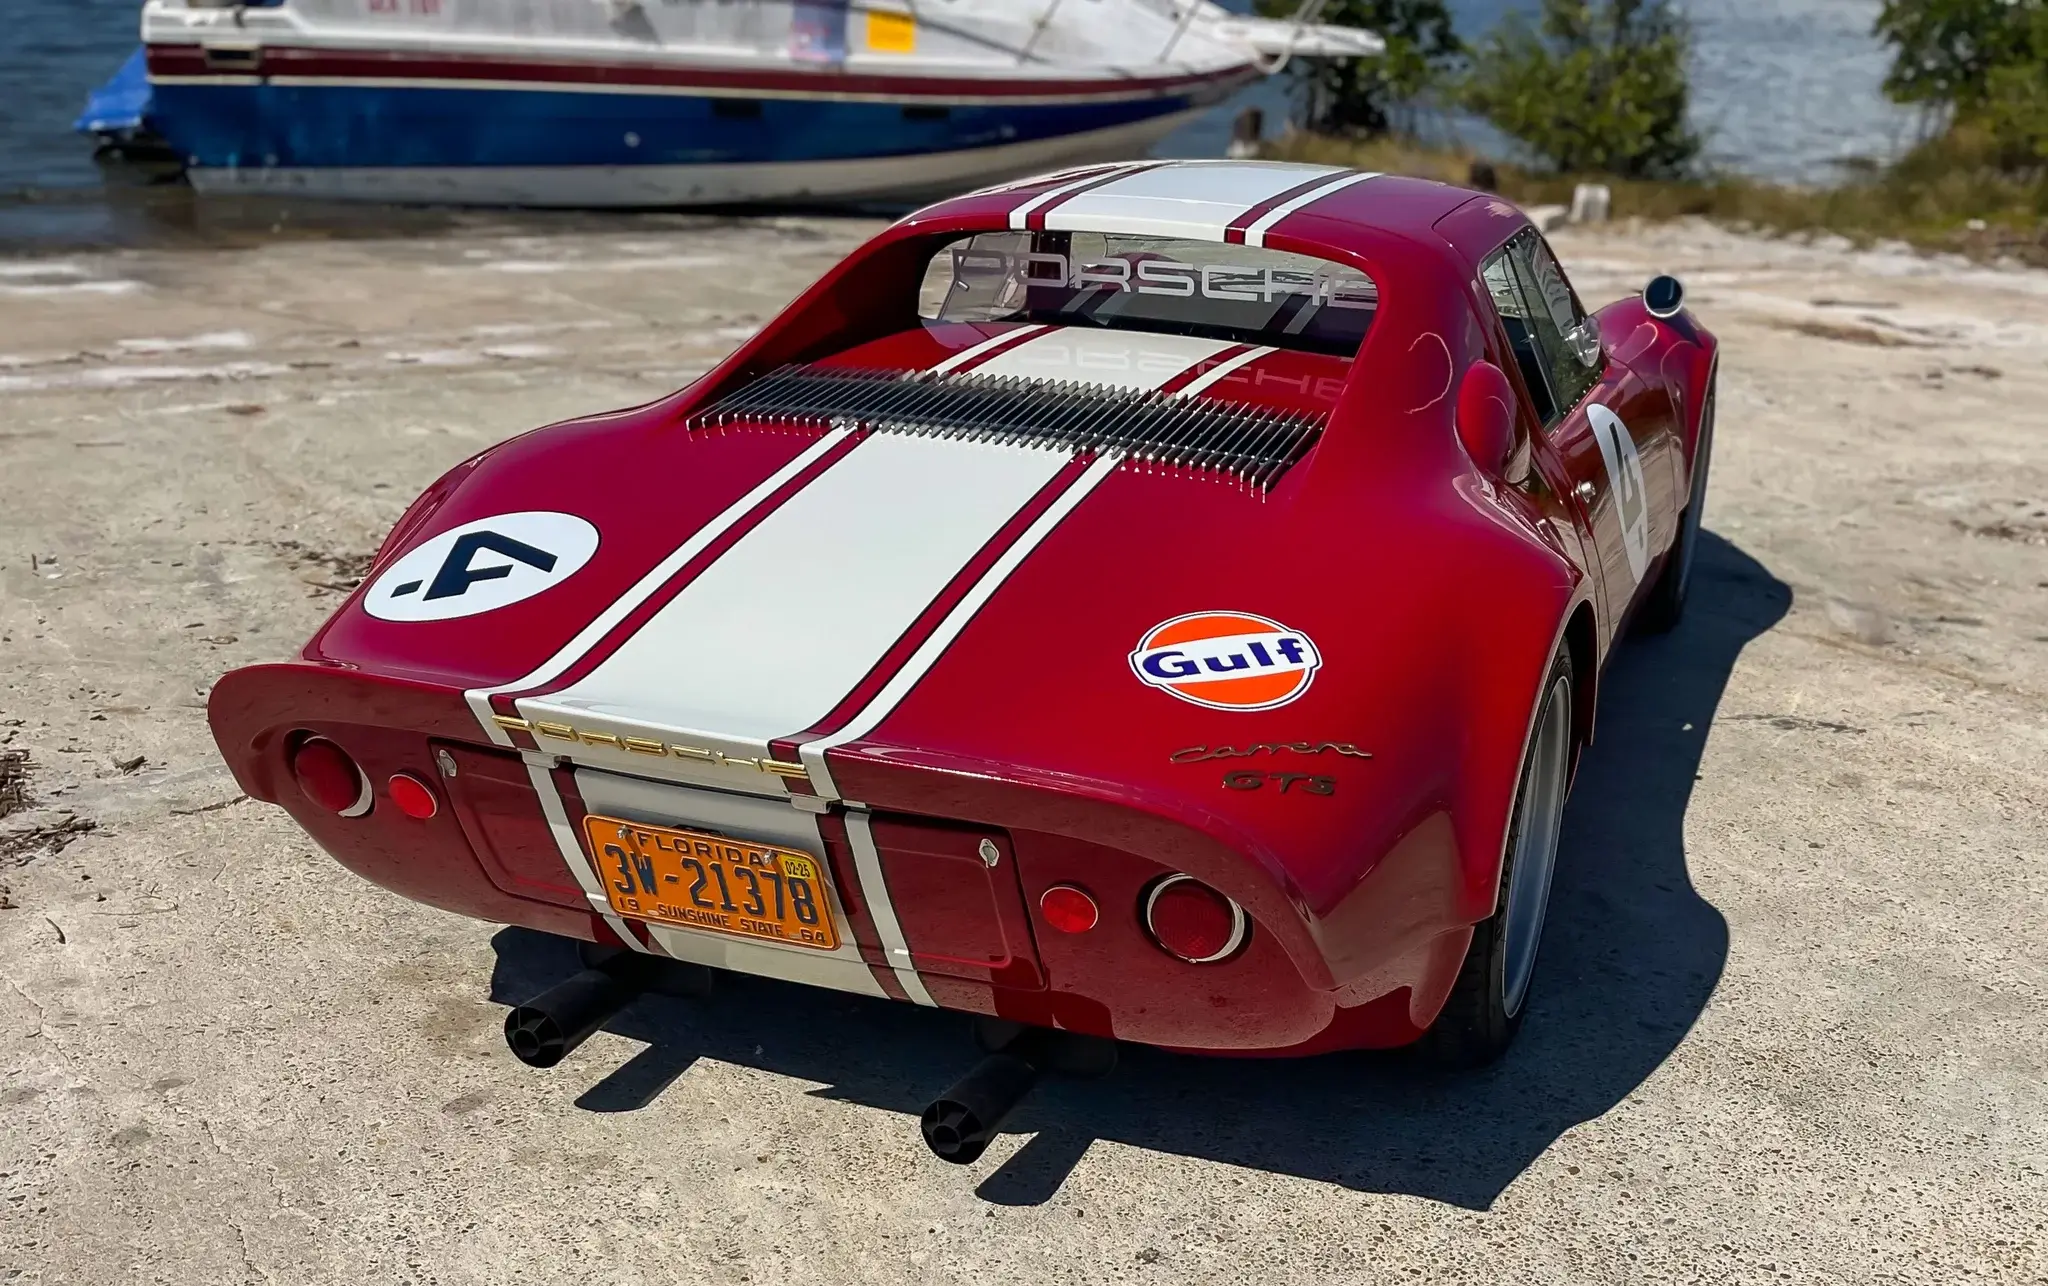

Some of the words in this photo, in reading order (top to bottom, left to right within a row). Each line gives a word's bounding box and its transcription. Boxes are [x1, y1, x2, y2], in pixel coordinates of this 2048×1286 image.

[953, 248, 1378, 309] PORSCHE
[1609, 421, 1643, 550] 4
[1142, 638, 1304, 679] Gulf
[492, 715, 810, 780] PORSCHE
[1222, 770, 1337, 796] GTS
[637, 832, 768, 866] FLORIDA
[785, 860, 811, 878] 02-25
[603, 843, 820, 926] 3W-21378
[618, 896, 640, 911] 19
[656, 902, 730, 928] SUNSHINE
[740, 918, 784, 938] STATE
